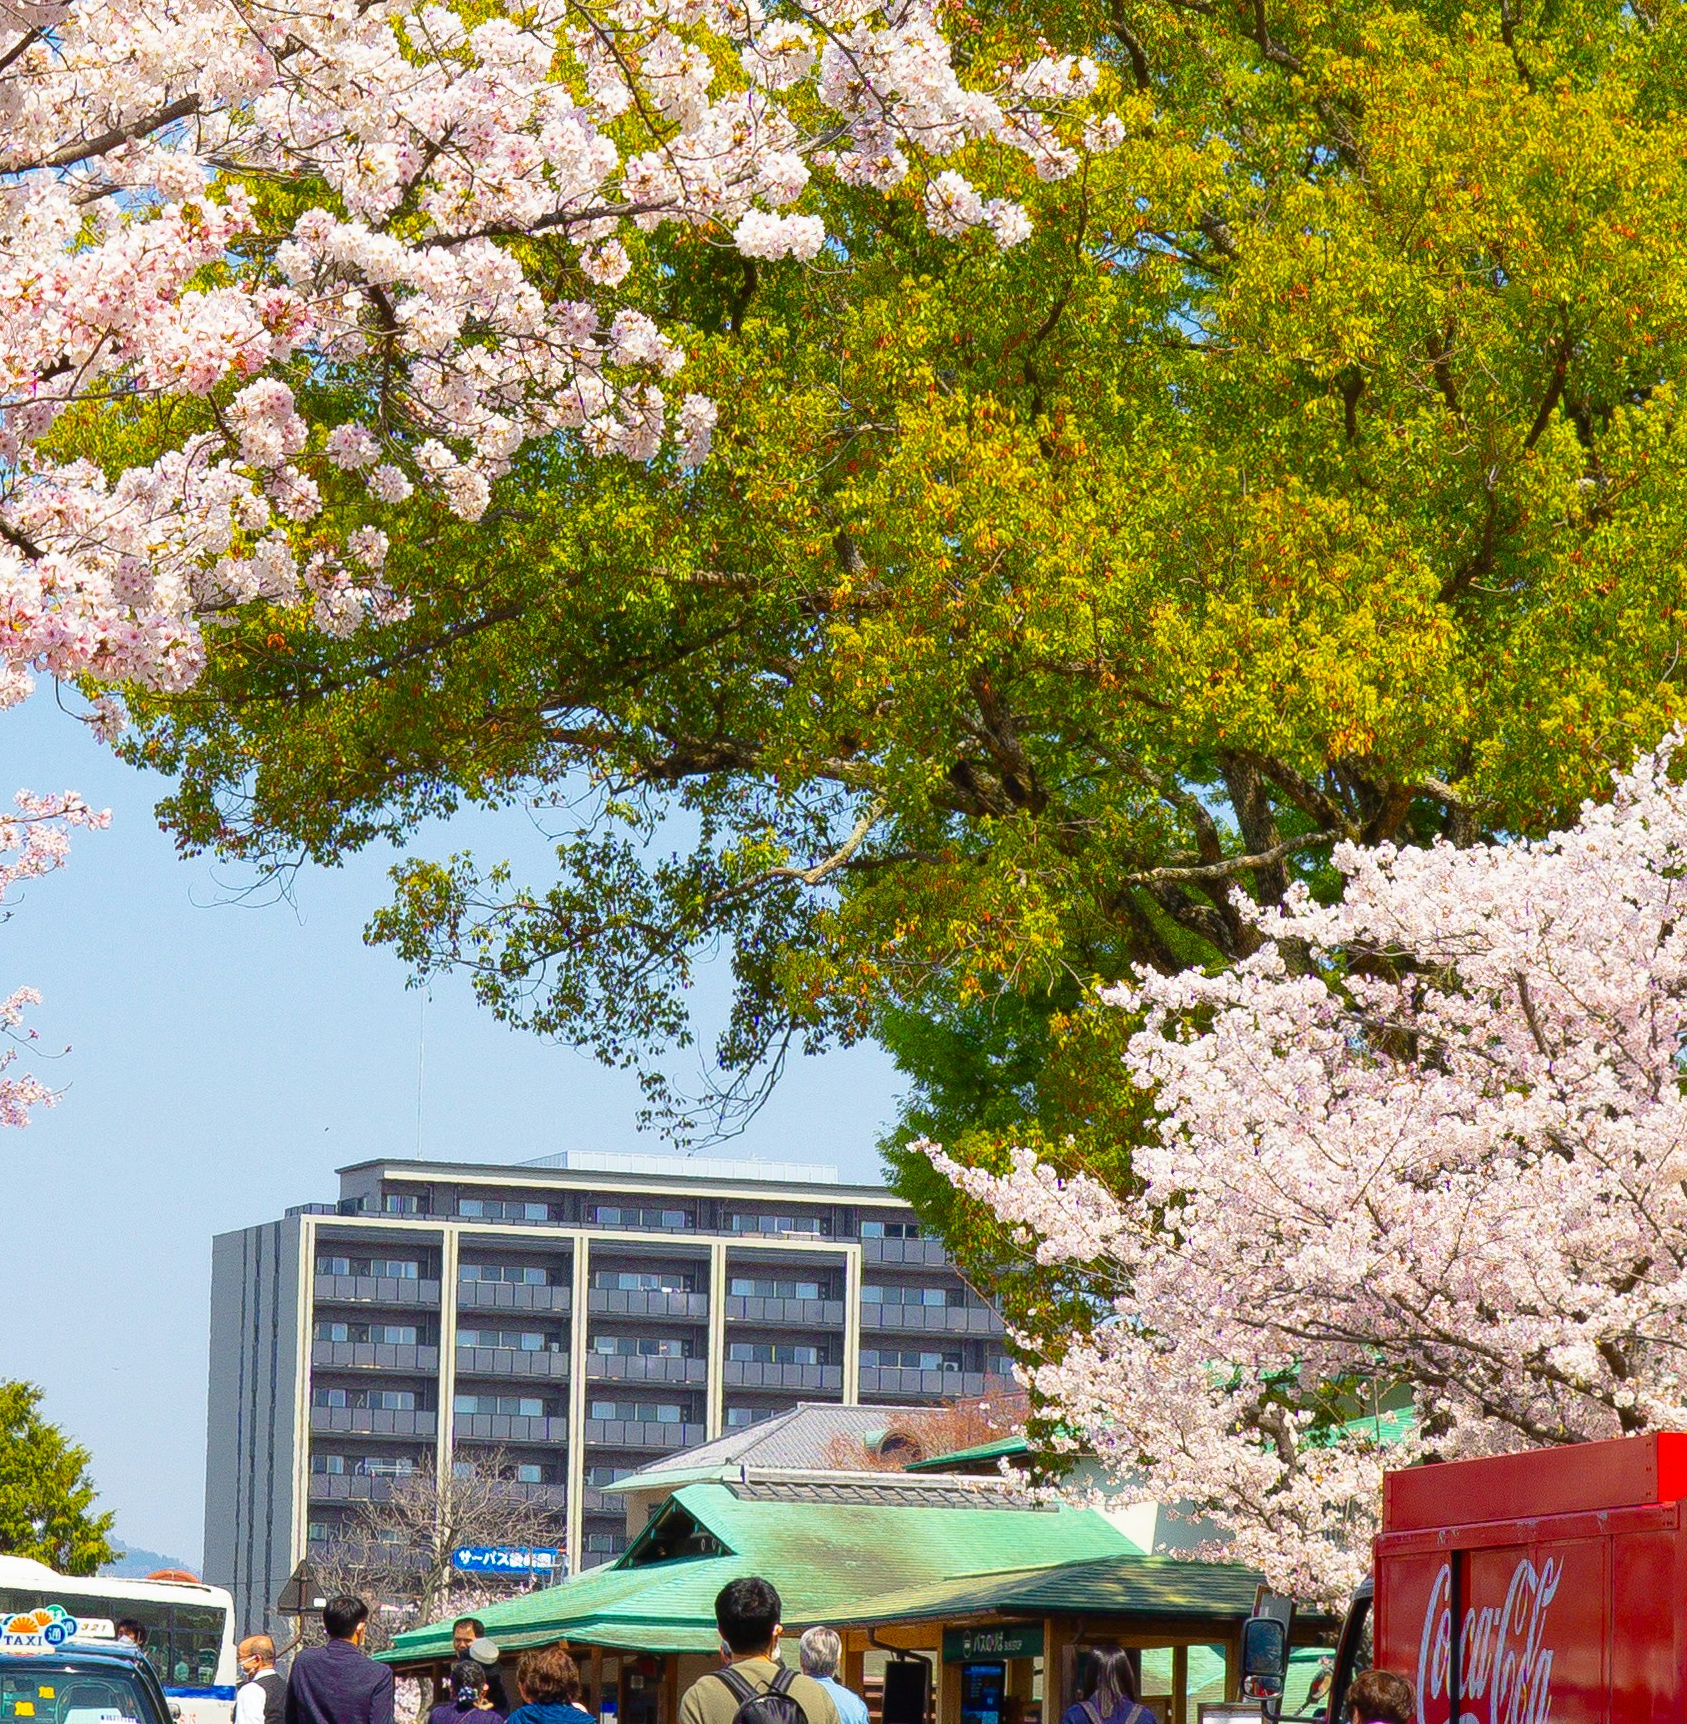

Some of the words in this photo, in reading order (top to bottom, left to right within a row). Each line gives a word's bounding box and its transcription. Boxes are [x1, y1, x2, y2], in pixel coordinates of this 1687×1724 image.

[4, 1635, 42, 1646] TAXI
[973, 1631, 1004, 1653] バスのりば
